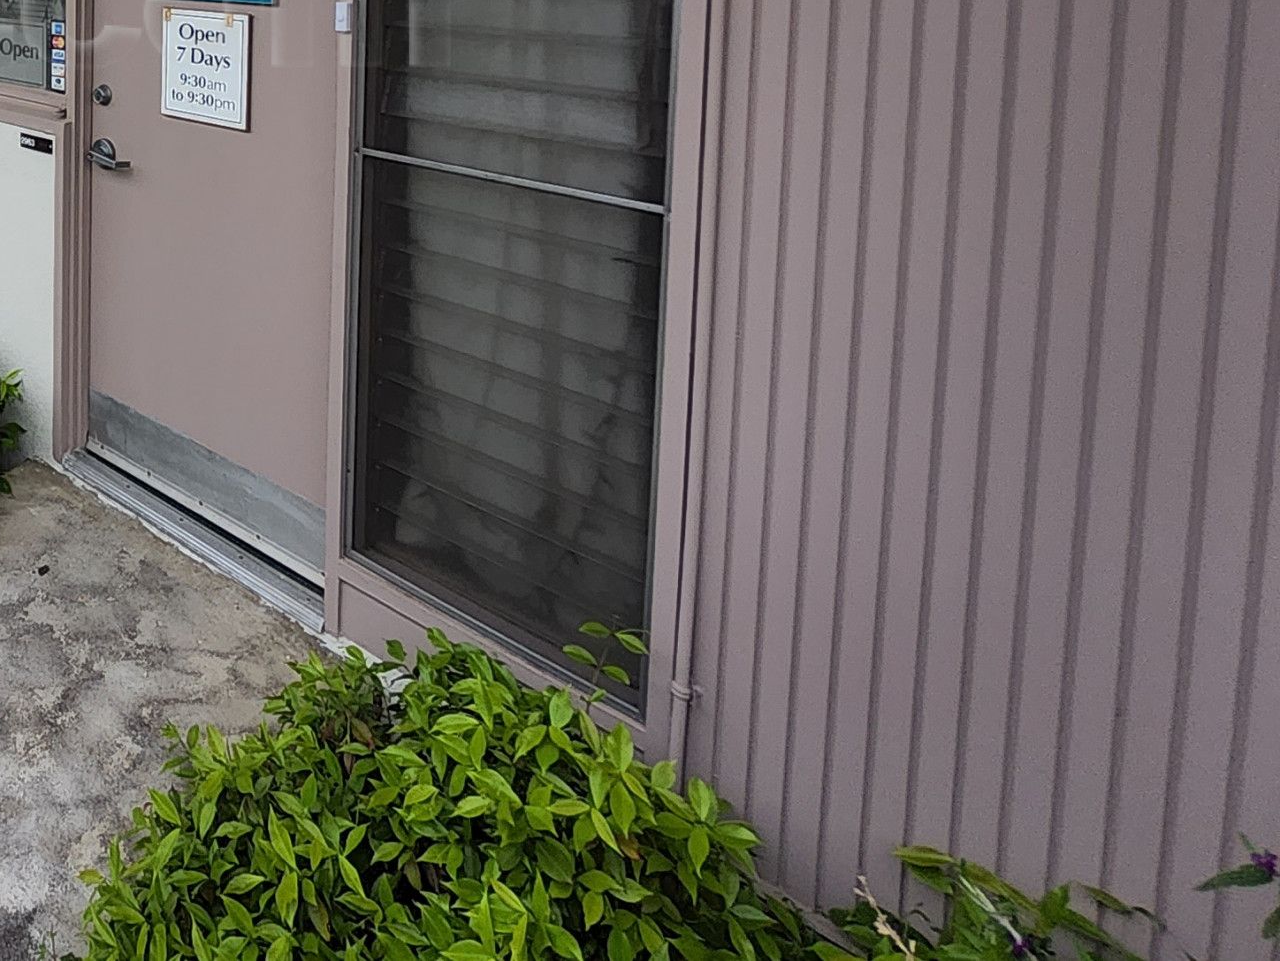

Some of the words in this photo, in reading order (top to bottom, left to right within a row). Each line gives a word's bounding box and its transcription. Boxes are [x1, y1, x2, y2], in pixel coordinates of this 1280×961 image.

[178, 22, 226, 45] Open
[0, 38, 40, 61] Open
[176, 46, 185, 62] 7
[190, 47, 231, 70] Days
[180, 72, 227, 93] 9:30am
[171, 88, 184, 102] to
[186, 90, 236, 113] 9:30pm
